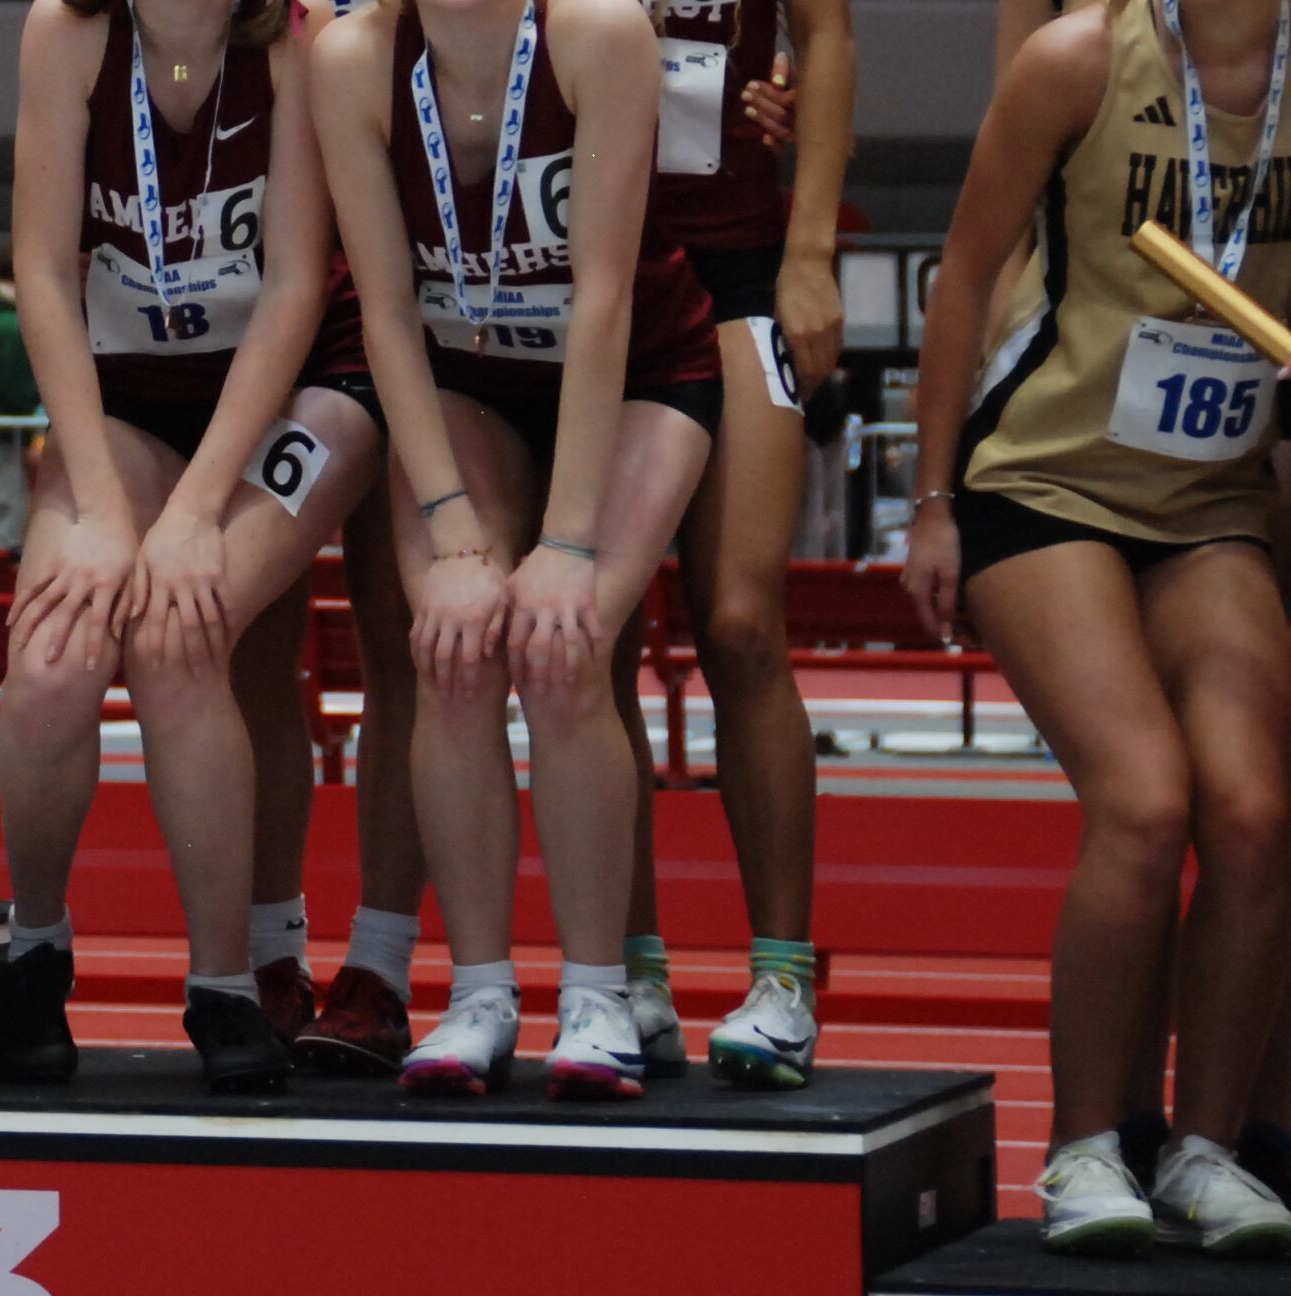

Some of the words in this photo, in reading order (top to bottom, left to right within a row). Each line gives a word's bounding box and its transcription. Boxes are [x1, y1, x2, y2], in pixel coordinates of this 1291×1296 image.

[220, 187, 259, 251] 6
[540, 155, 573, 240] 6
[137, 303, 210, 343] 18
[1156, 372, 1261, 439] 185
[262, 430, 316, 498] 6
